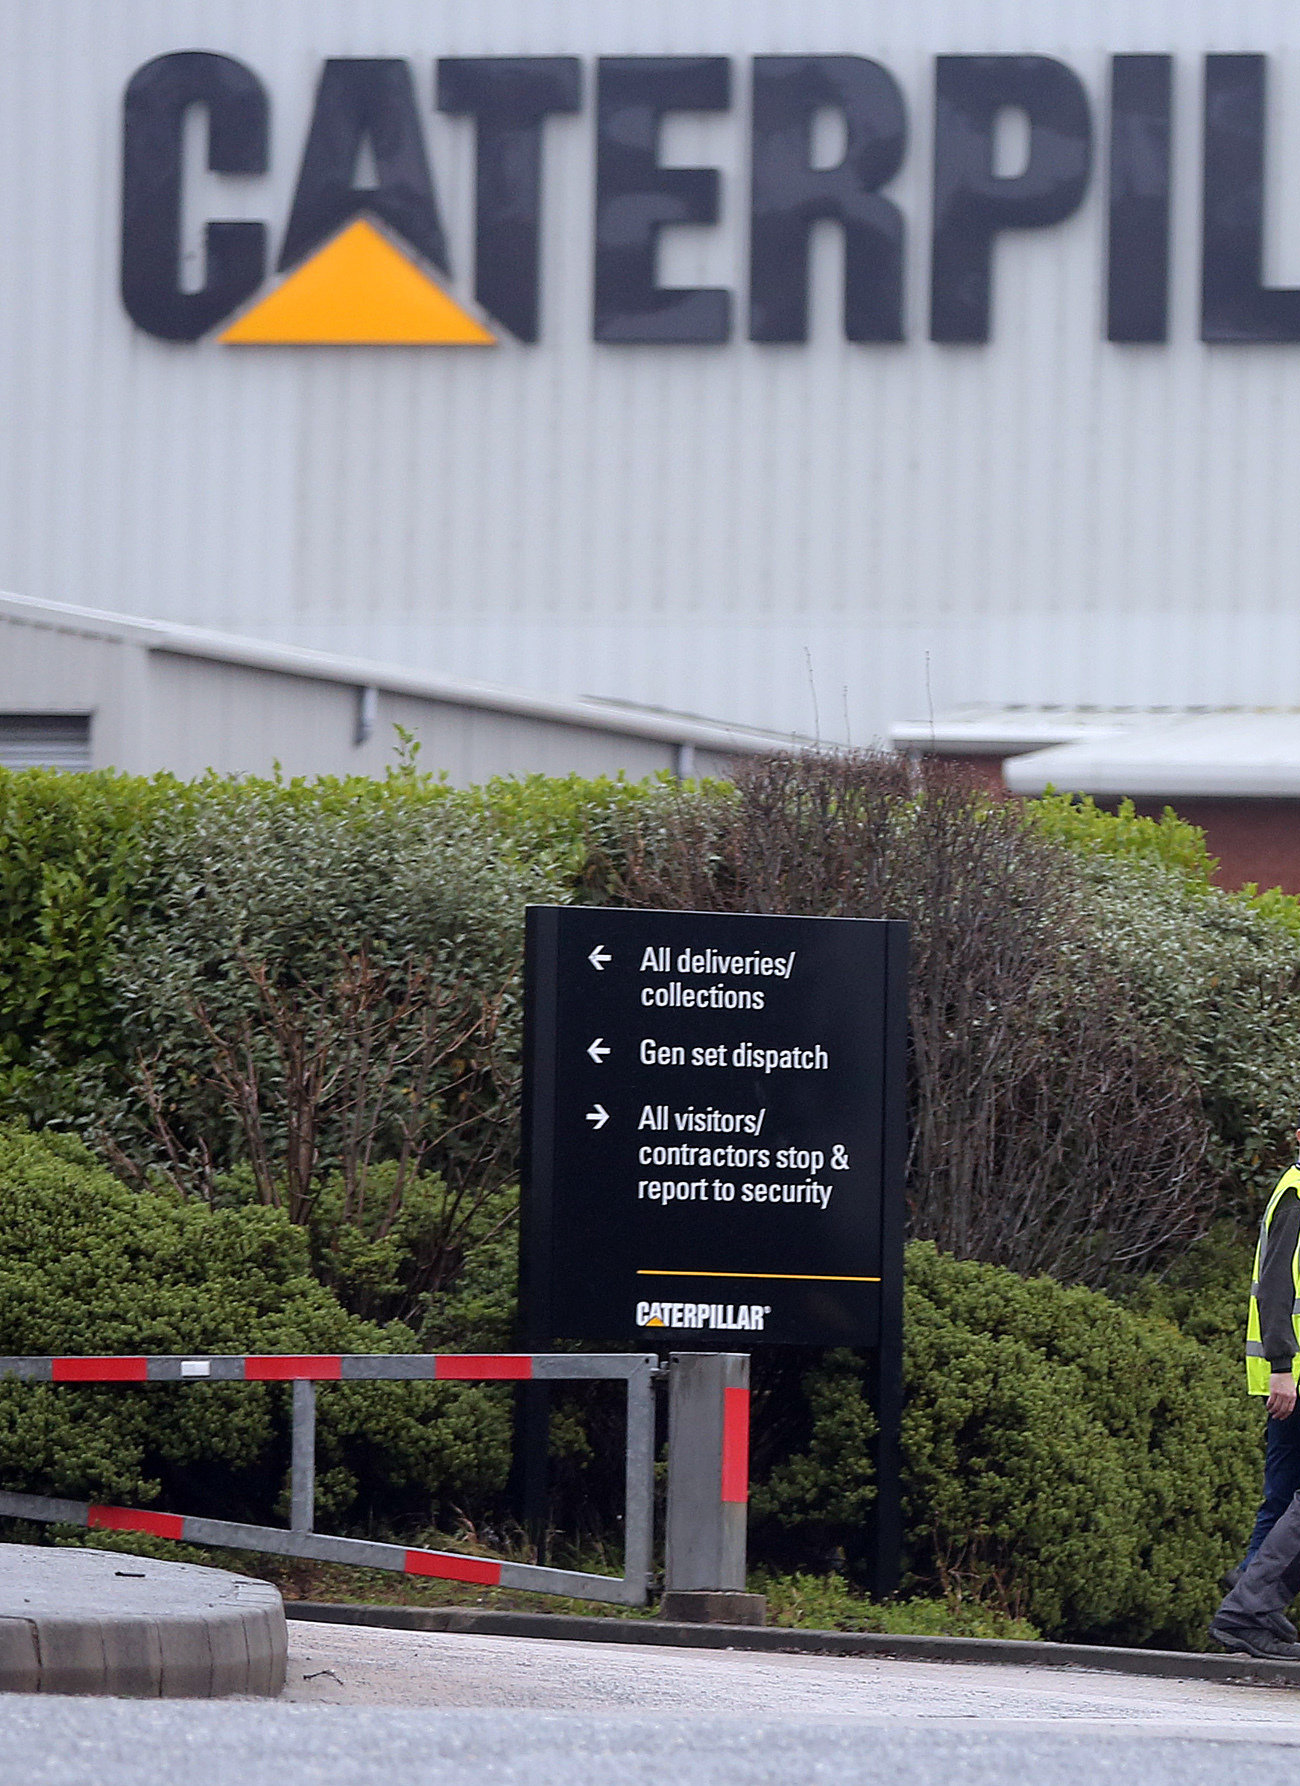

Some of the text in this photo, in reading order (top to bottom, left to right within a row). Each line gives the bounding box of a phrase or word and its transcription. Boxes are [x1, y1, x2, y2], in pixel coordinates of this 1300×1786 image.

[639, 946, 796, 979] All deliveries/
[641, 982, 765, 1010] collections
[639, 1039, 829, 1074] Gen set dispatch
[638, 1105, 766, 1136] All visitors/
[638, 1144, 850, 1174] contractors stop &
[638, 1178, 833, 1209] report to security
